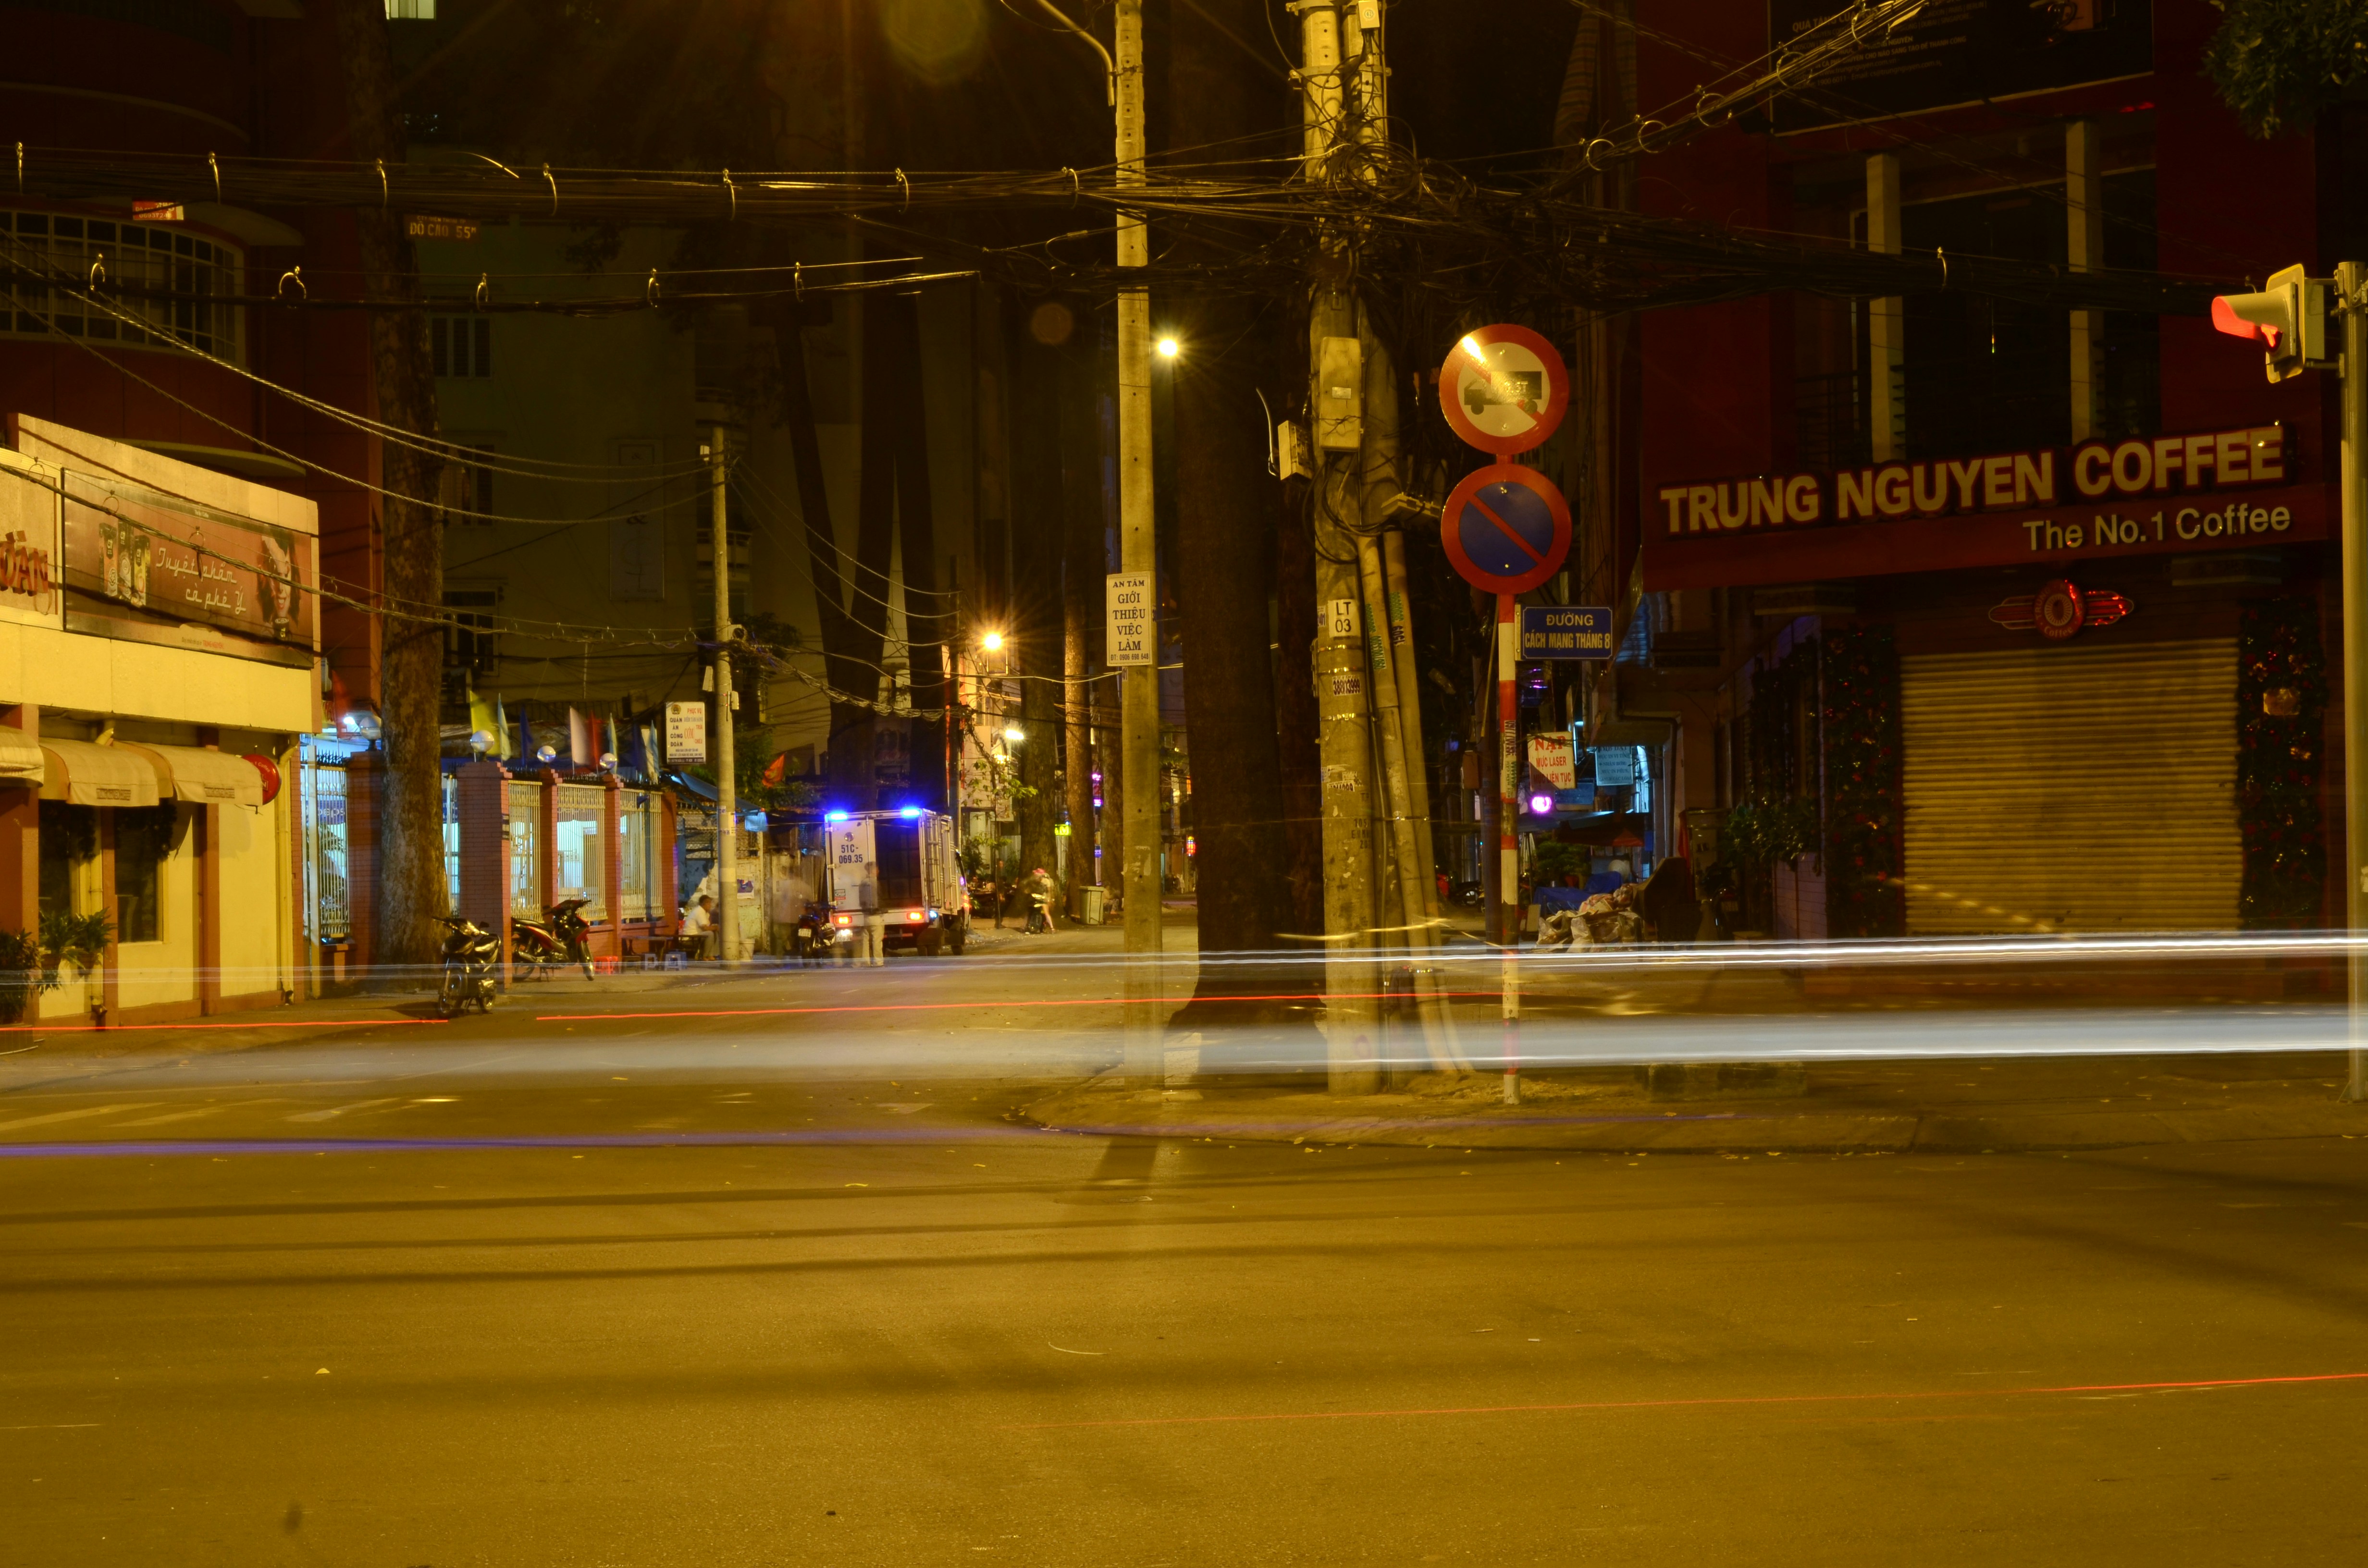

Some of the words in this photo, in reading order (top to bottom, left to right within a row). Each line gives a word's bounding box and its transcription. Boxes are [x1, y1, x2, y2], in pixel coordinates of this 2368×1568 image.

[1660, 474, 1820, 534] TRUNG
[1837, 452, 2054, 520] NGUYEN
[2073, 425, 2283, 497] COFFEE
[2022, 518, 2084, 551] The
[2094, 508, 2165, 544] No.1
[2175, 504, 2291, 541] Coffee
[1126, 578, 1145, 587] TÂM
[185, 583, 202, 603] cà
[204, 588, 231, 609] phê
[1118, 590, 1141, 604] GIỚI
[1112, 606, 1146, 621] THIỆU
[1336, 602, 1351, 615] LT
[1335, 619, 1352, 633] 03
[1546, 612, 1593, 626] ĐƯỜNG
[1116, 623, 1142, 637] VIỆC
[2044, 626, 2073, 638] Coffee
[1118, 638, 1141, 651] LÀM
[1525, 629, 1546, 648] CÁCH
[1548, 633, 1574, 650] MẠNG
[1576, 630, 1603, 649] THÁNG
[1604, 633, 1611, 649] 8
[1534, 735, 1566, 753] NẠP
[1536, 755, 1548, 770] MỰC
[1549, 756, 1567, 767] LASER
[1560, 772, 1572, 785] TỤC
[841, 844, 859, 853] 51C-
[839, 854, 863, 864] 069.35
